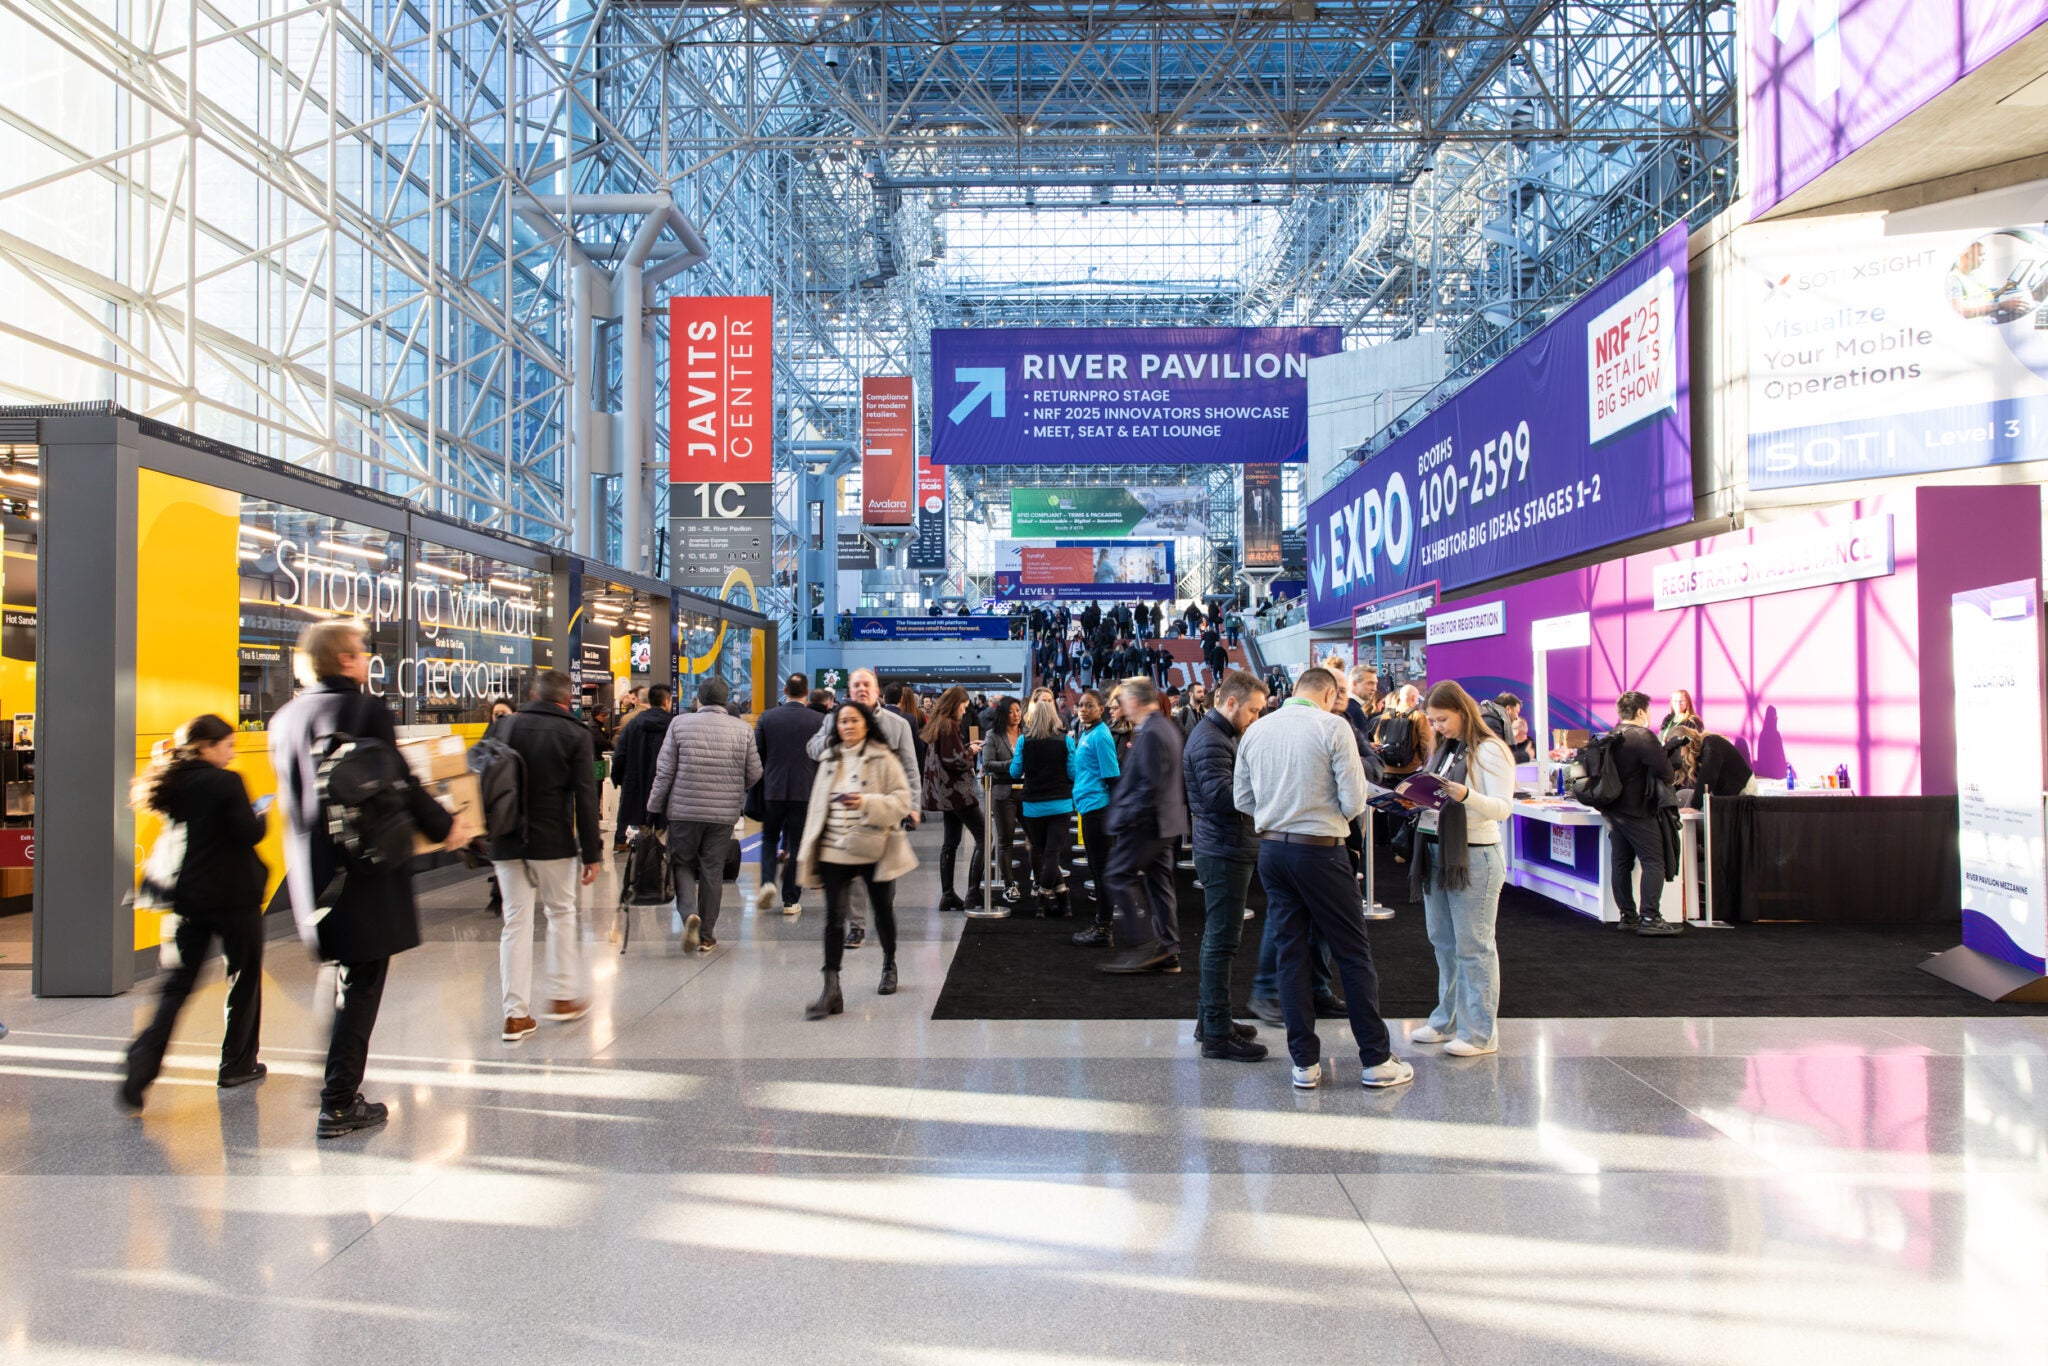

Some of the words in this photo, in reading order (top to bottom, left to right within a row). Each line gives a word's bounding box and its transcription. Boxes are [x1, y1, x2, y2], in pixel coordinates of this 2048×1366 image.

[1763, 306, 1886, 341] Visualize
[1596, 315, 1631, 368] NRF
[1764, 347, 1825, 371] Your
[1835, 327, 1933, 359] Mobile
[1023, 354, 1128, 380] RIVER
[1141, 352, 1308, 380] PAVILION
[1596, 340, 1660, 394] RETAIL'S
[1764, 362, 1921, 400] Operations
[688, 321, 716, 456] JAVITS
[730, 320, 752, 458] CENTER
[866, 394, 908, 402] Compliance
[1034, 389, 1120, 402] RETURNPRO
[1123, 389, 1170, 402] STAGE
[1597, 393, 1616, 420] BIG
[1620, 367, 1660, 407] SHOW
[1034, 407, 1060, 420] NRF
[1064, 406, 1101, 420] 2025
[1104, 406, 1201, 420] INNOVATORS
[1204, 406, 1290, 420] SHOWCASE
[1034, 425, 1074, 440] MEET,
[1078, 424, 1115, 438] SEAT
[1118, 424, 1130, 438] &
[1132, 424, 1160, 437] EAT
[1162, 424, 1221, 438] LOUNGE
[1765, 429, 1896, 472] SOTI
[1925, 421, 1994, 449] Level
[2004, 419, 2021, 438] 3
[1418, 436, 1452, 475] BOOTHS
[1420, 420, 1530, 528] 100-2599
[694, 482, 746, 518] 1C
[868, 499, 907, 508] Avalara
[1330, 471, 1411, 590] EXPO
[1422, 534, 1468, 566] EXHIBITOR
[1468, 528, 1486, 550] BIG
[1489, 514, 1520, 542] IDEAS
[1524, 485, 1573, 528] STAGES
[1576, 474, 1601, 508] 1-2
[1248, 552, 1279, 560] #4265
[276, 540, 440, 639] Shopping
[448, 578, 536, 637] without
[1662, 560, 1761, 596] REGISTRATION
[6, 614, 17, 624] Hot
[1430, 619, 1457, 636] EXHIBITOR
[1458, 612, 1498, 632] REGISTRATION
[242, 650, 252, 660] Tea
[258, 651, 280, 662] Lemonade
[436, 638, 446, 648] Grab
[450, 639, 455, 648] Go
[398, 642, 513, 700] checkout
[570, 672, 581, 682] Walk
[571, 659, 580, 670] Just
[572, 684, 580, 695] Out
[1966, 872, 1978, 882] RIVER
[1979, 875, 1999, 888] PAVILION
[2000, 880, 2028, 895] MEZZANINE
